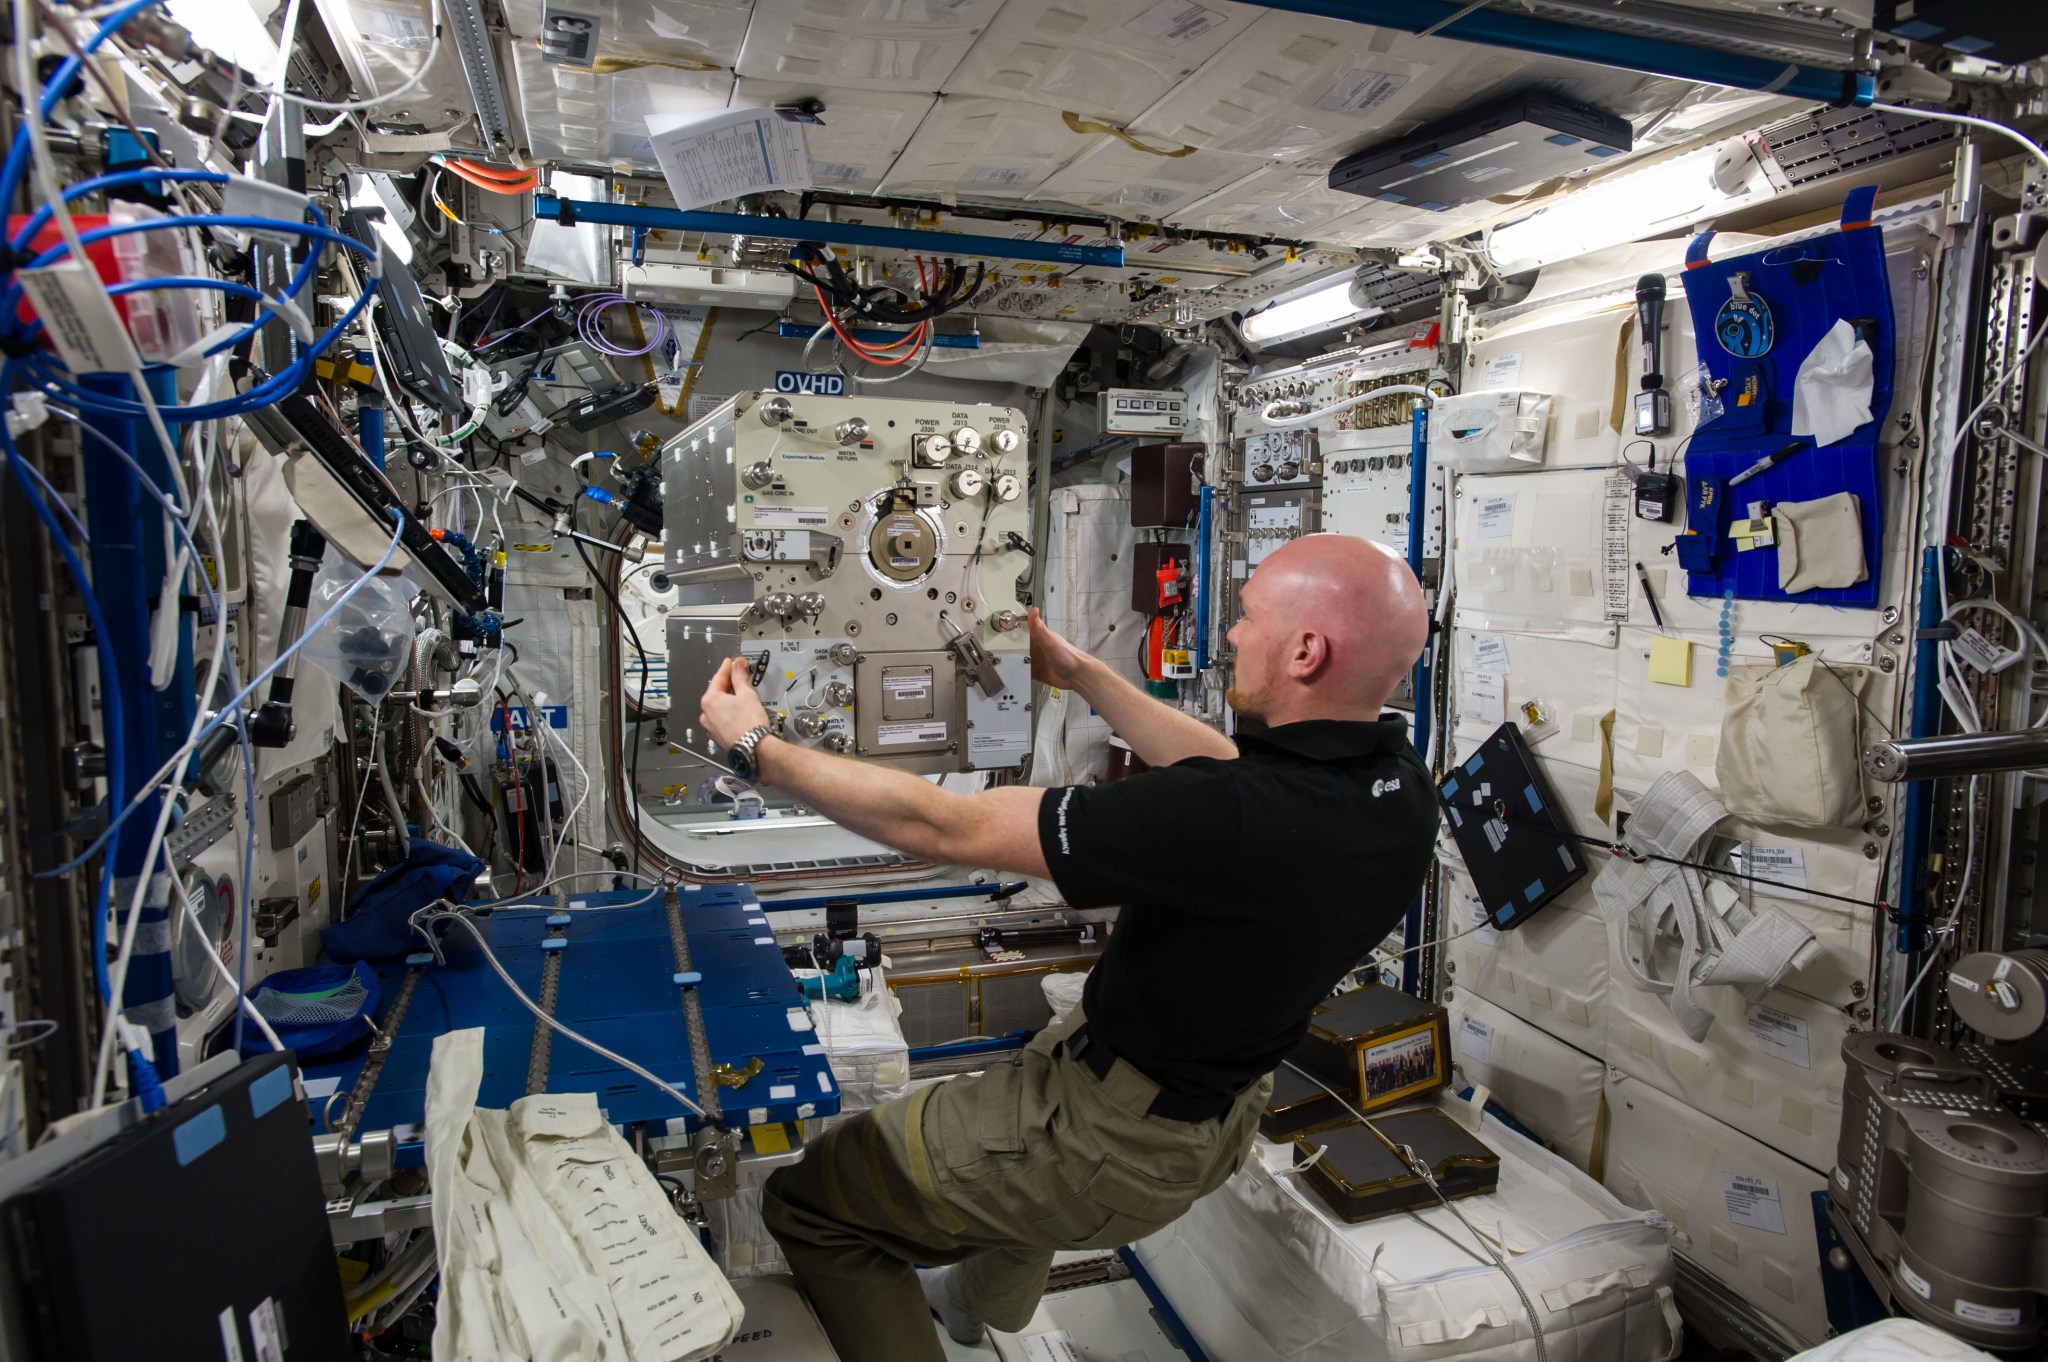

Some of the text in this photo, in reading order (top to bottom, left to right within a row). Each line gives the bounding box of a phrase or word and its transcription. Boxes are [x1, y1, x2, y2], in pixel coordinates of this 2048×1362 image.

[1730, 302, 1760, 320] blue dot
[777, 373, 844, 396] OVHD
[915, 418, 940, 426] POWER
[989, 416, 1010, 424] POWER
[782, 454, 808, 462] Experiment
[1384, 778, 1401, 792] esa
